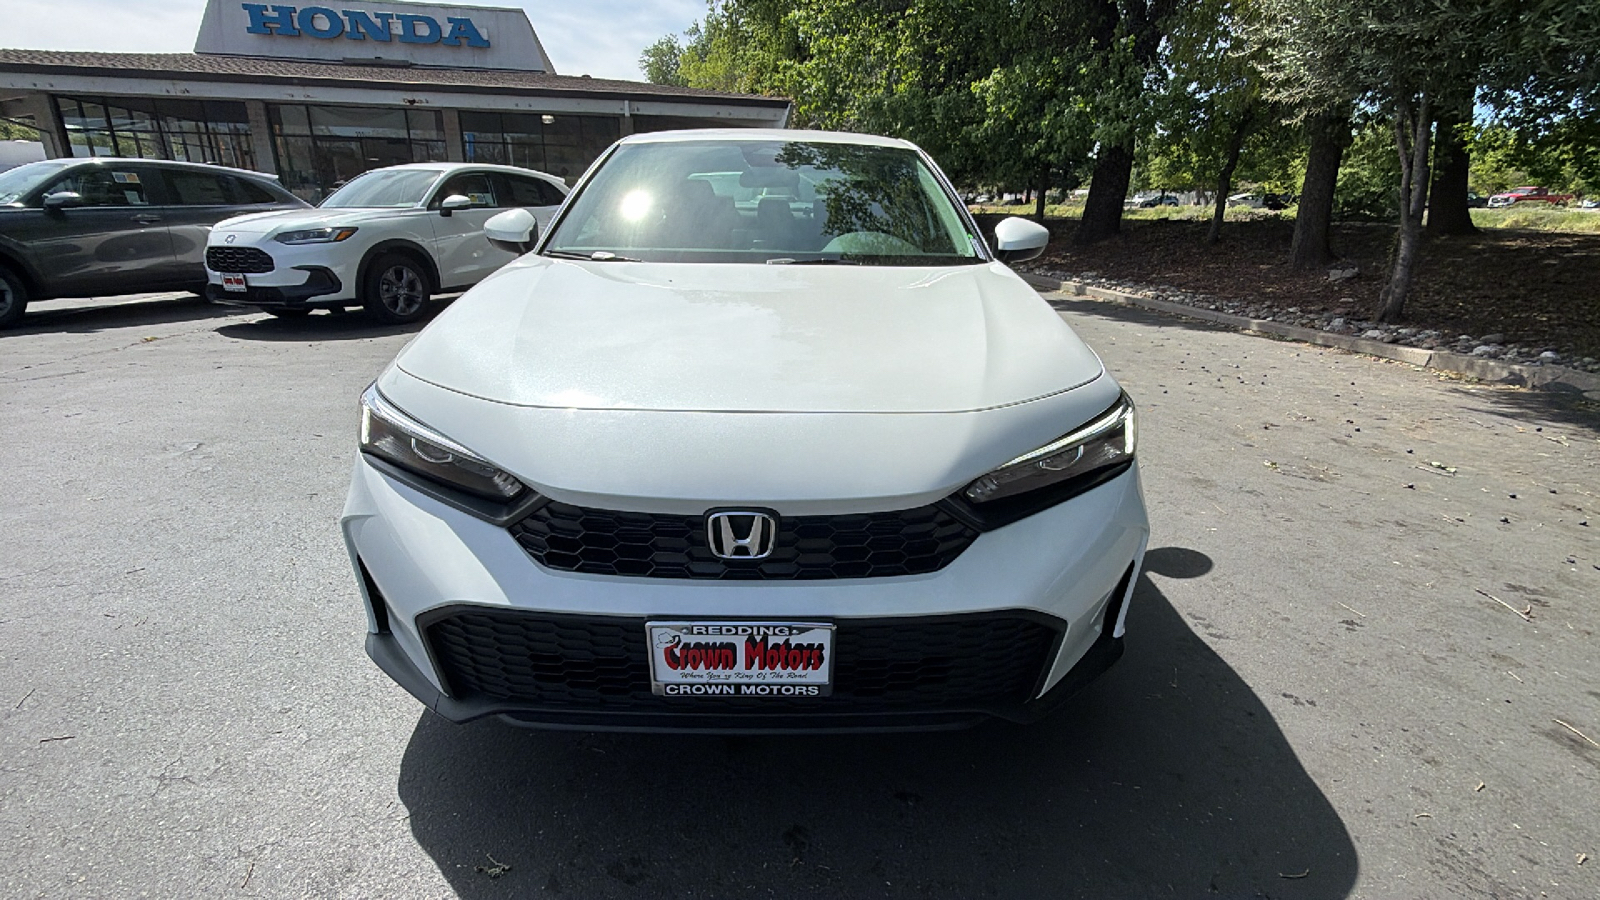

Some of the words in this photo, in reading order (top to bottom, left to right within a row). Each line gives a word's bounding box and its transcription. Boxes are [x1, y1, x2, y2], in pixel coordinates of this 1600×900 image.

[242, 3, 491, 48] HONDA
[692, 626, 790, 636] REDDING
[663, 636, 737, 671] Crown
[745, 635, 825, 671] Motors
[680, 671, 704, 679] Where
[706, 671, 732, 680] You're
[734, 671, 754, 680] King
[756, 672, 767, 680] Of
[770, 671, 784, 679] The
[666, 685, 735, 696] CROWN
[741, 685, 819, 696] MOTORS
